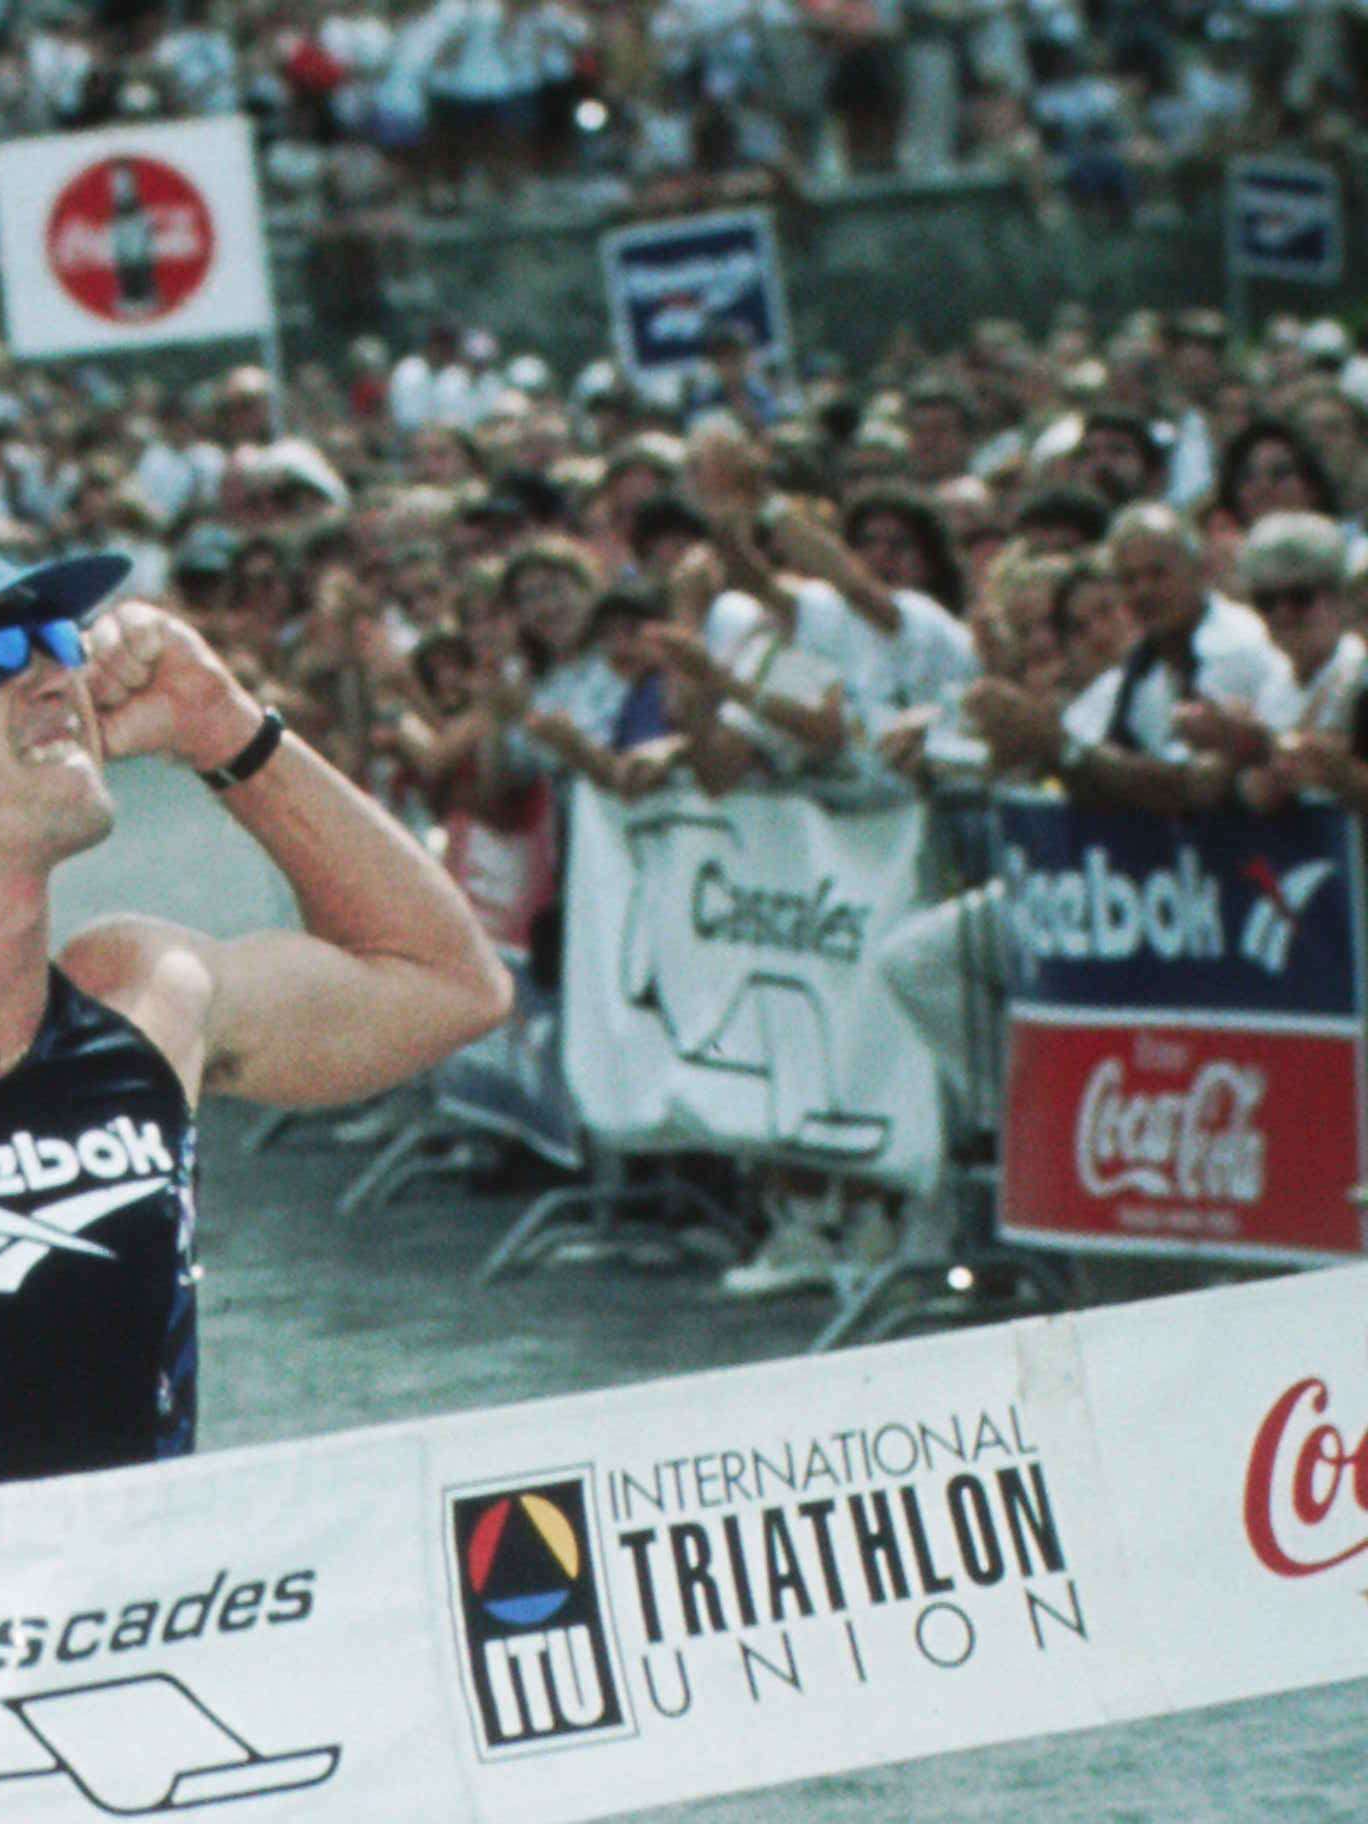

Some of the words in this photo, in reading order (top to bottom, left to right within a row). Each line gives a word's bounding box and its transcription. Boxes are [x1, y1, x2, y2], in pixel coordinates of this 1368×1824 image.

[608, 1404, 1039, 1522] INTERNATIONAL
[619, 1461, 1067, 1645] TRIATHLON
[484, 1623, 606, 1738] ITU
[642, 1579, 1088, 1719] UNION
